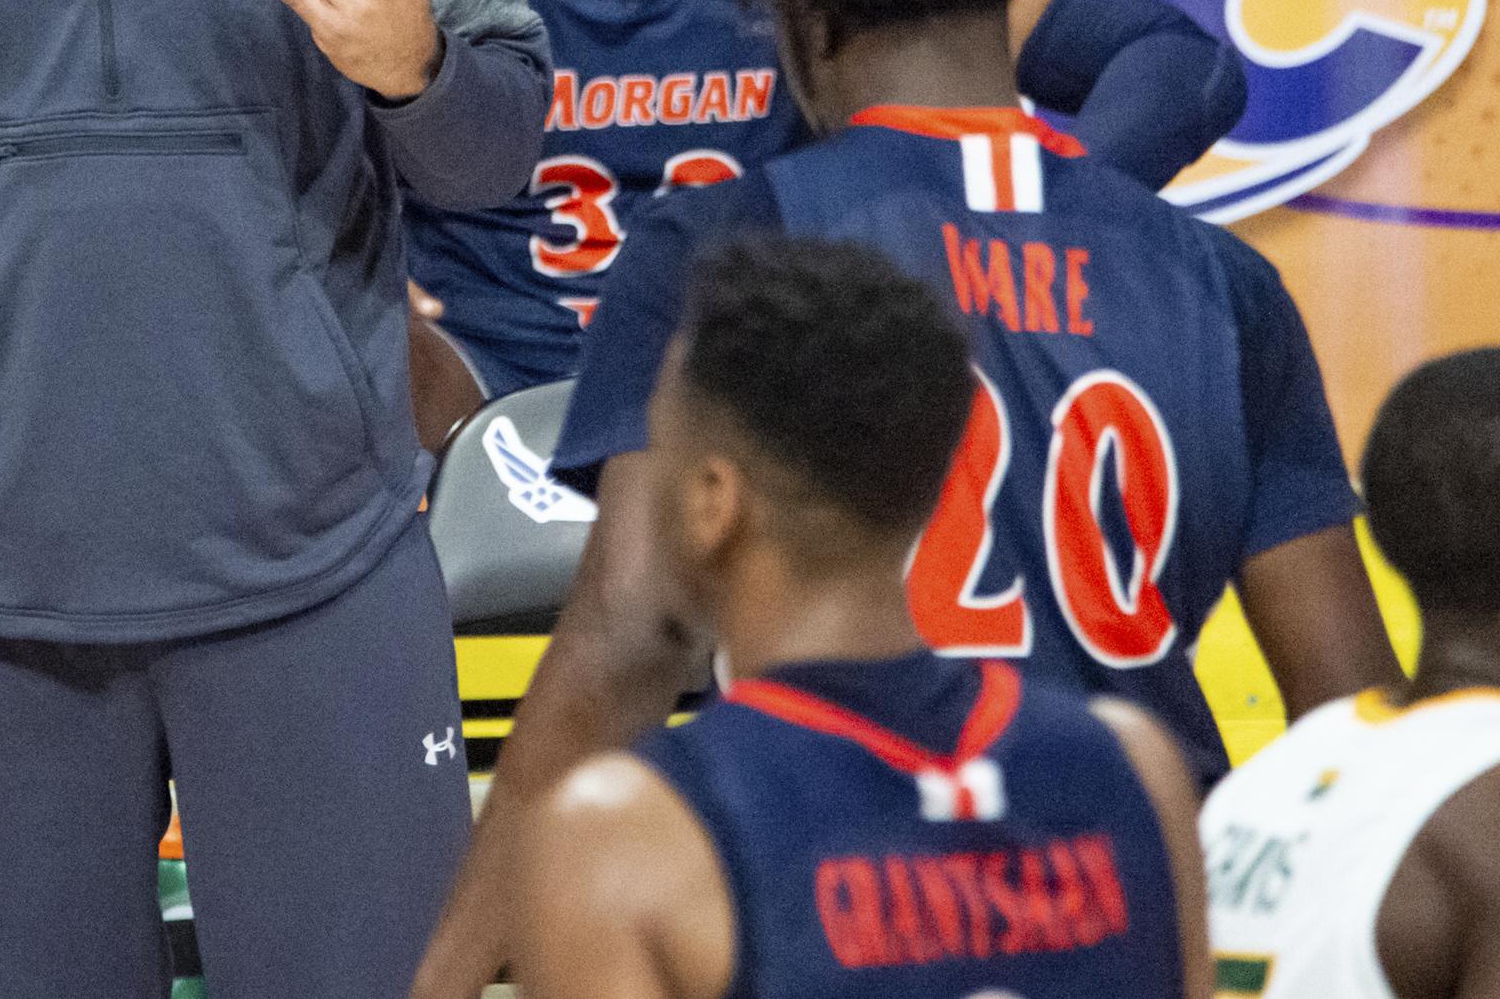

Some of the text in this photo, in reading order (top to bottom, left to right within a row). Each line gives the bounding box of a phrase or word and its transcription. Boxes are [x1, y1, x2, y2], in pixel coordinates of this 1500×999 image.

[528, 149, 746, 278] 3
[941, 221, 1094, 338] WARE
[902, 365, 1180, 670] 20
